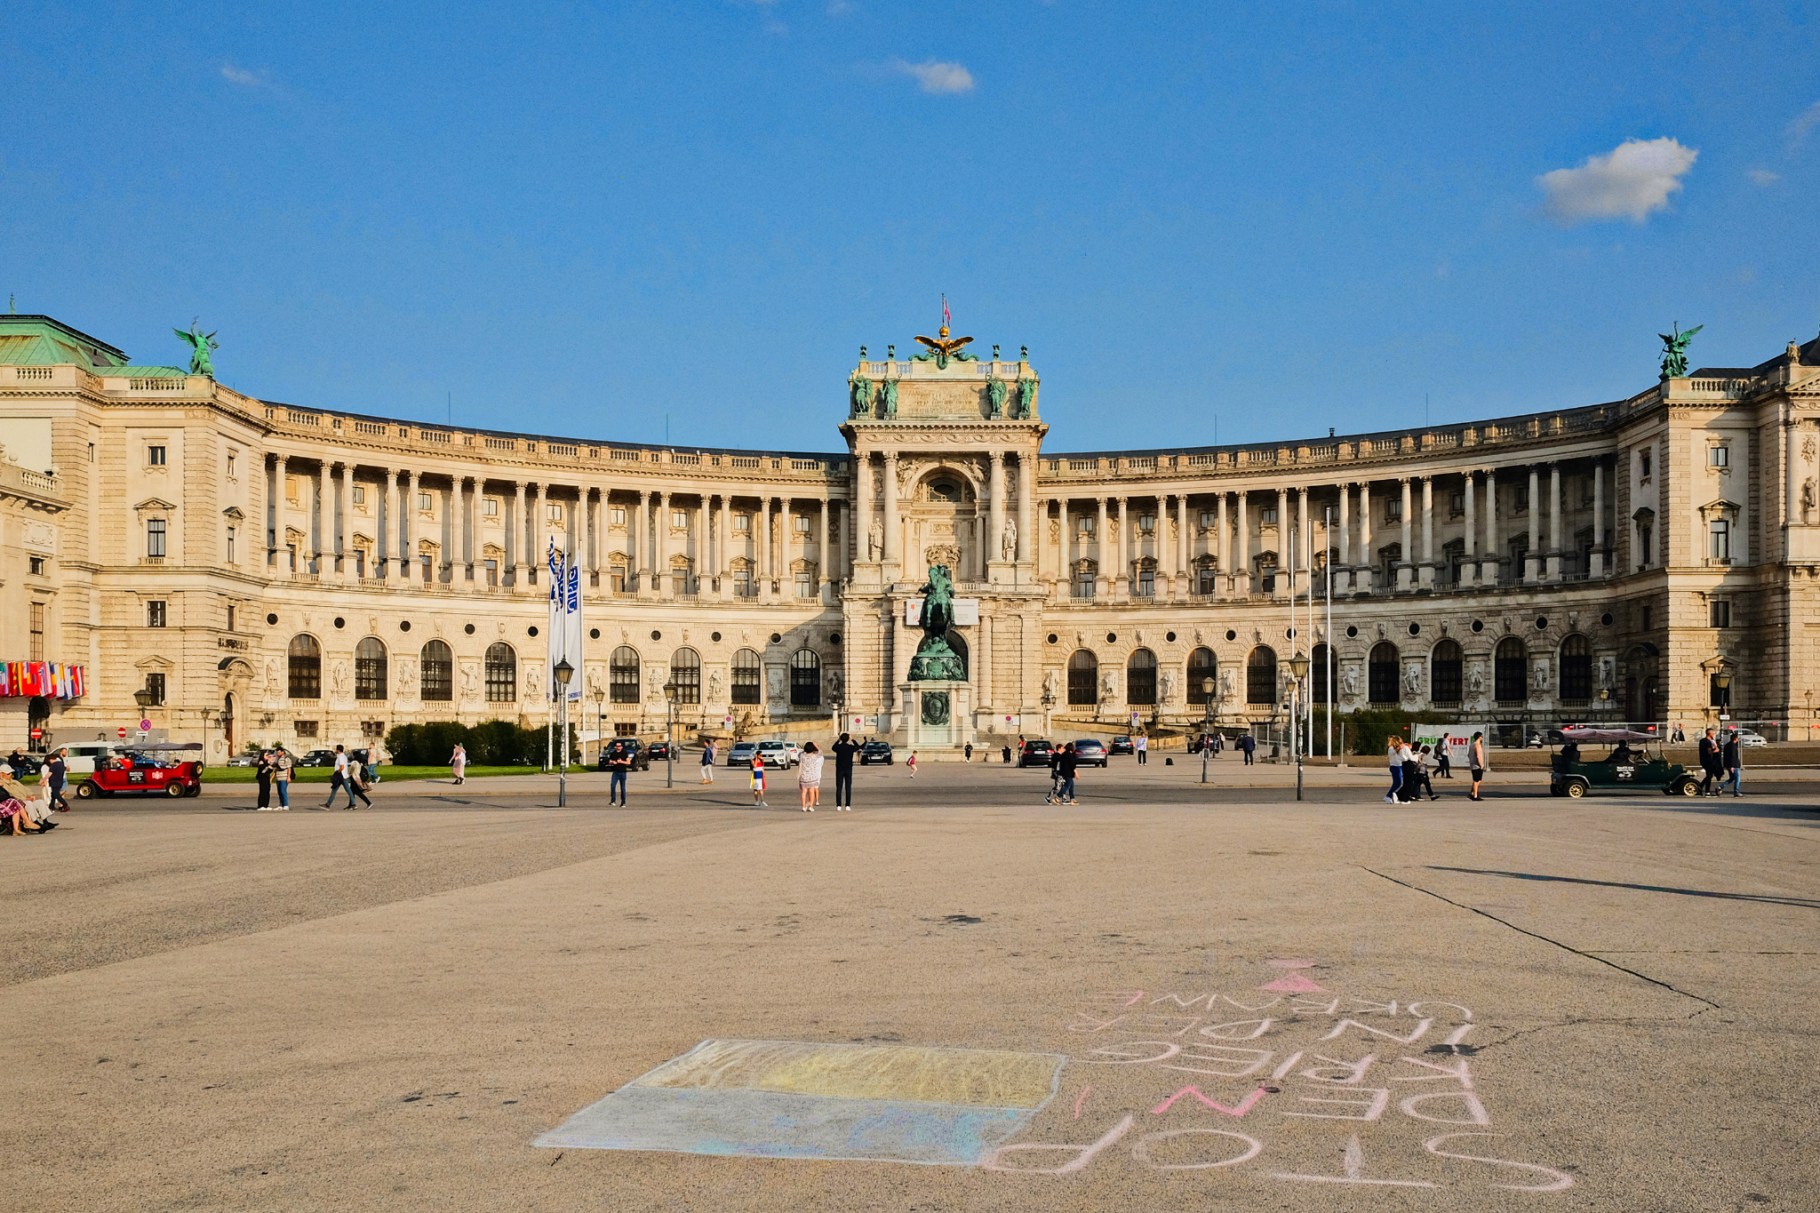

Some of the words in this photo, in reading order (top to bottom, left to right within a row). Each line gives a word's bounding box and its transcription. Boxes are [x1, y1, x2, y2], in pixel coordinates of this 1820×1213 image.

[1096, 990, 1473, 1019] UKRAINE
[1067, 1011, 1278, 1041] DER
[1318, 1017, 1477, 1055] IN
[1070, 1040, 1474, 1091] KRIEG
[981, 1113, 1575, 1192] STOP
